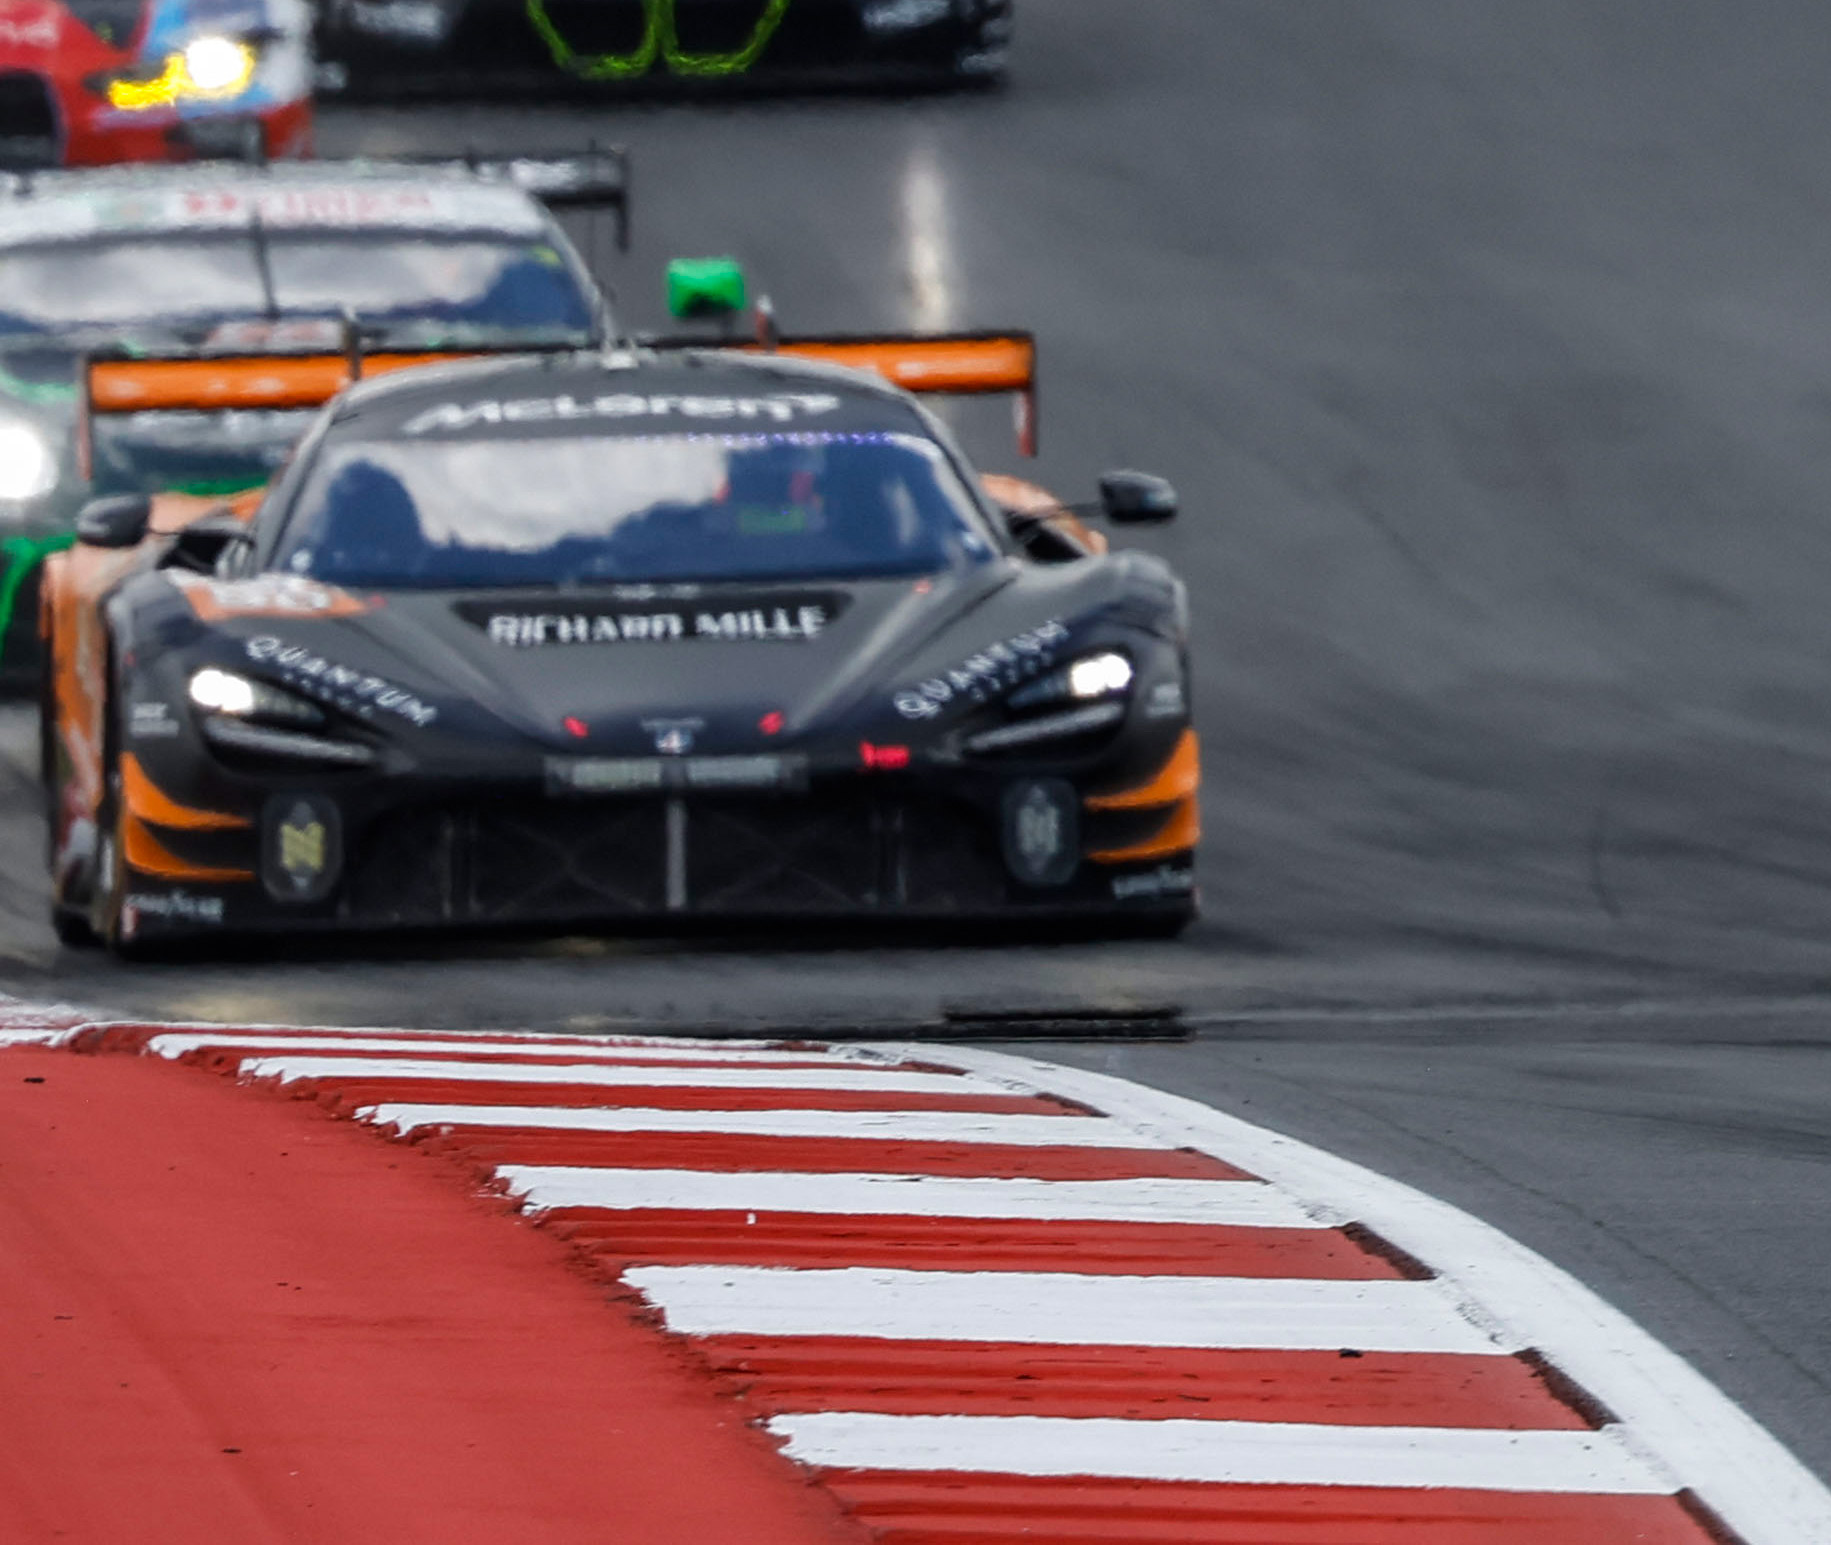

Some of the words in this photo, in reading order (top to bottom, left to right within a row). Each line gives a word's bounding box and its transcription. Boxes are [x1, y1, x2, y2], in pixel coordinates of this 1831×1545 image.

[402, 394, 798, 434] McLaren
[489, 613, 684, 646] RICHARD
[697, 606, 826, 639] MILLE
[247, 635, 438, 727] QUANTUM
